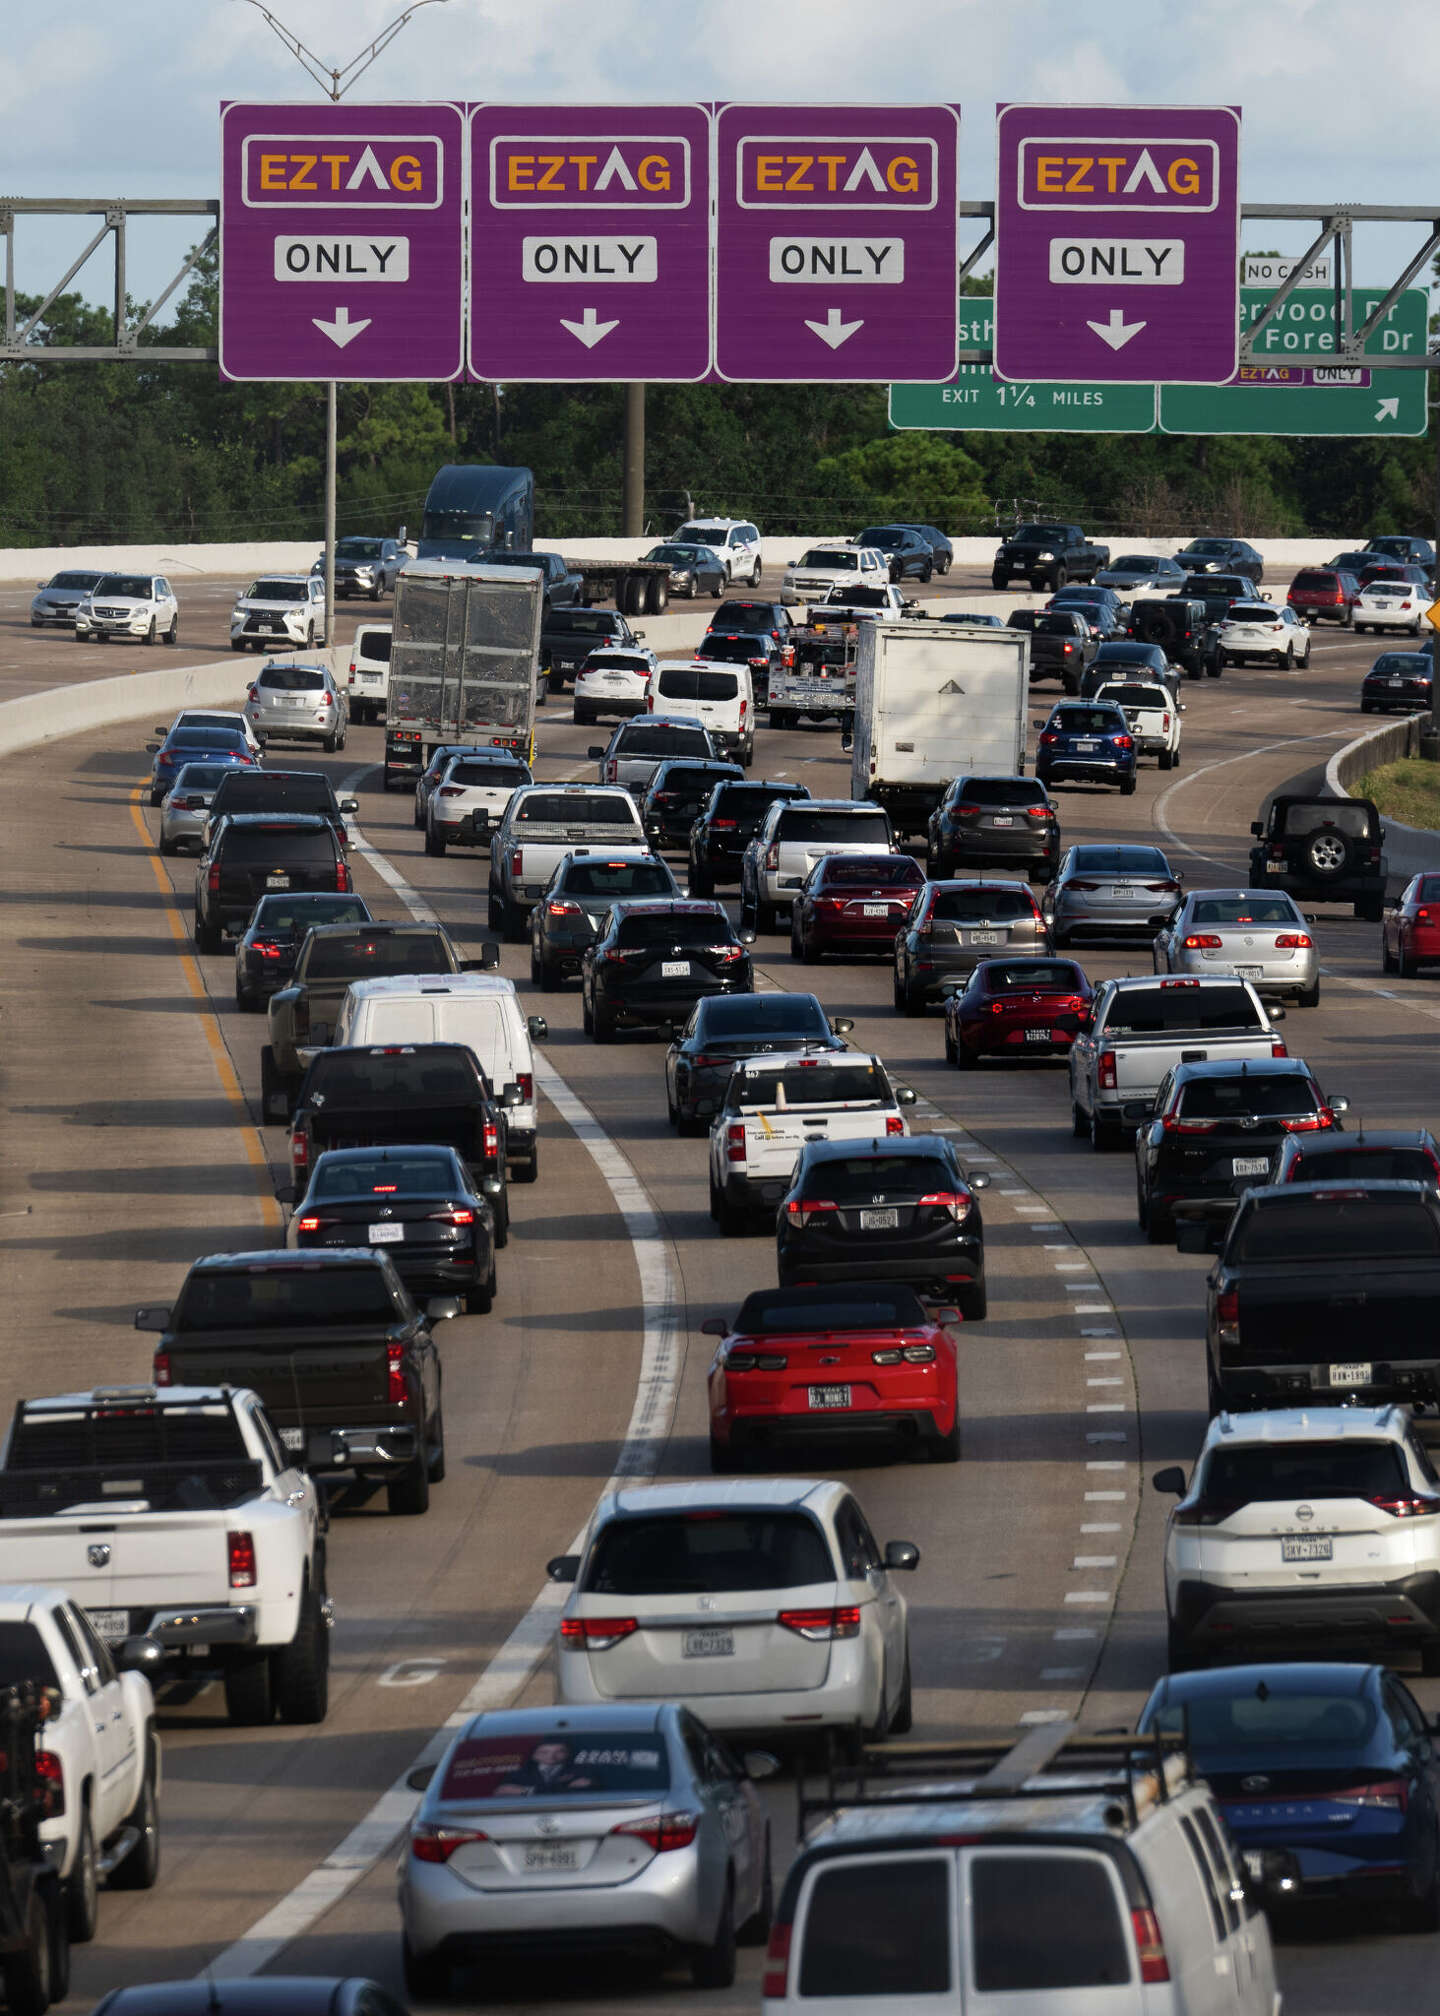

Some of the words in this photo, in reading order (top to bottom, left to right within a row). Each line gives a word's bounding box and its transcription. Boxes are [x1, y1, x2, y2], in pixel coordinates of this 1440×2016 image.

[285, 244, 397, 273] ONLY
[534, 244, 645, 274] ONLY
[781, 245, 892, 275] ONLY
[1061, 246, 1172, 277] ONLY
[1248, 265, 1273, 278] NO
[1278, 265, 1326, 279] CSH
[1383, 330, 1413, 351] Dr
[1317, 366, 1357, 380] ONLY
[942, 389, 980, 403] EXIT
[1053, 392, 1104, 406] MILES
